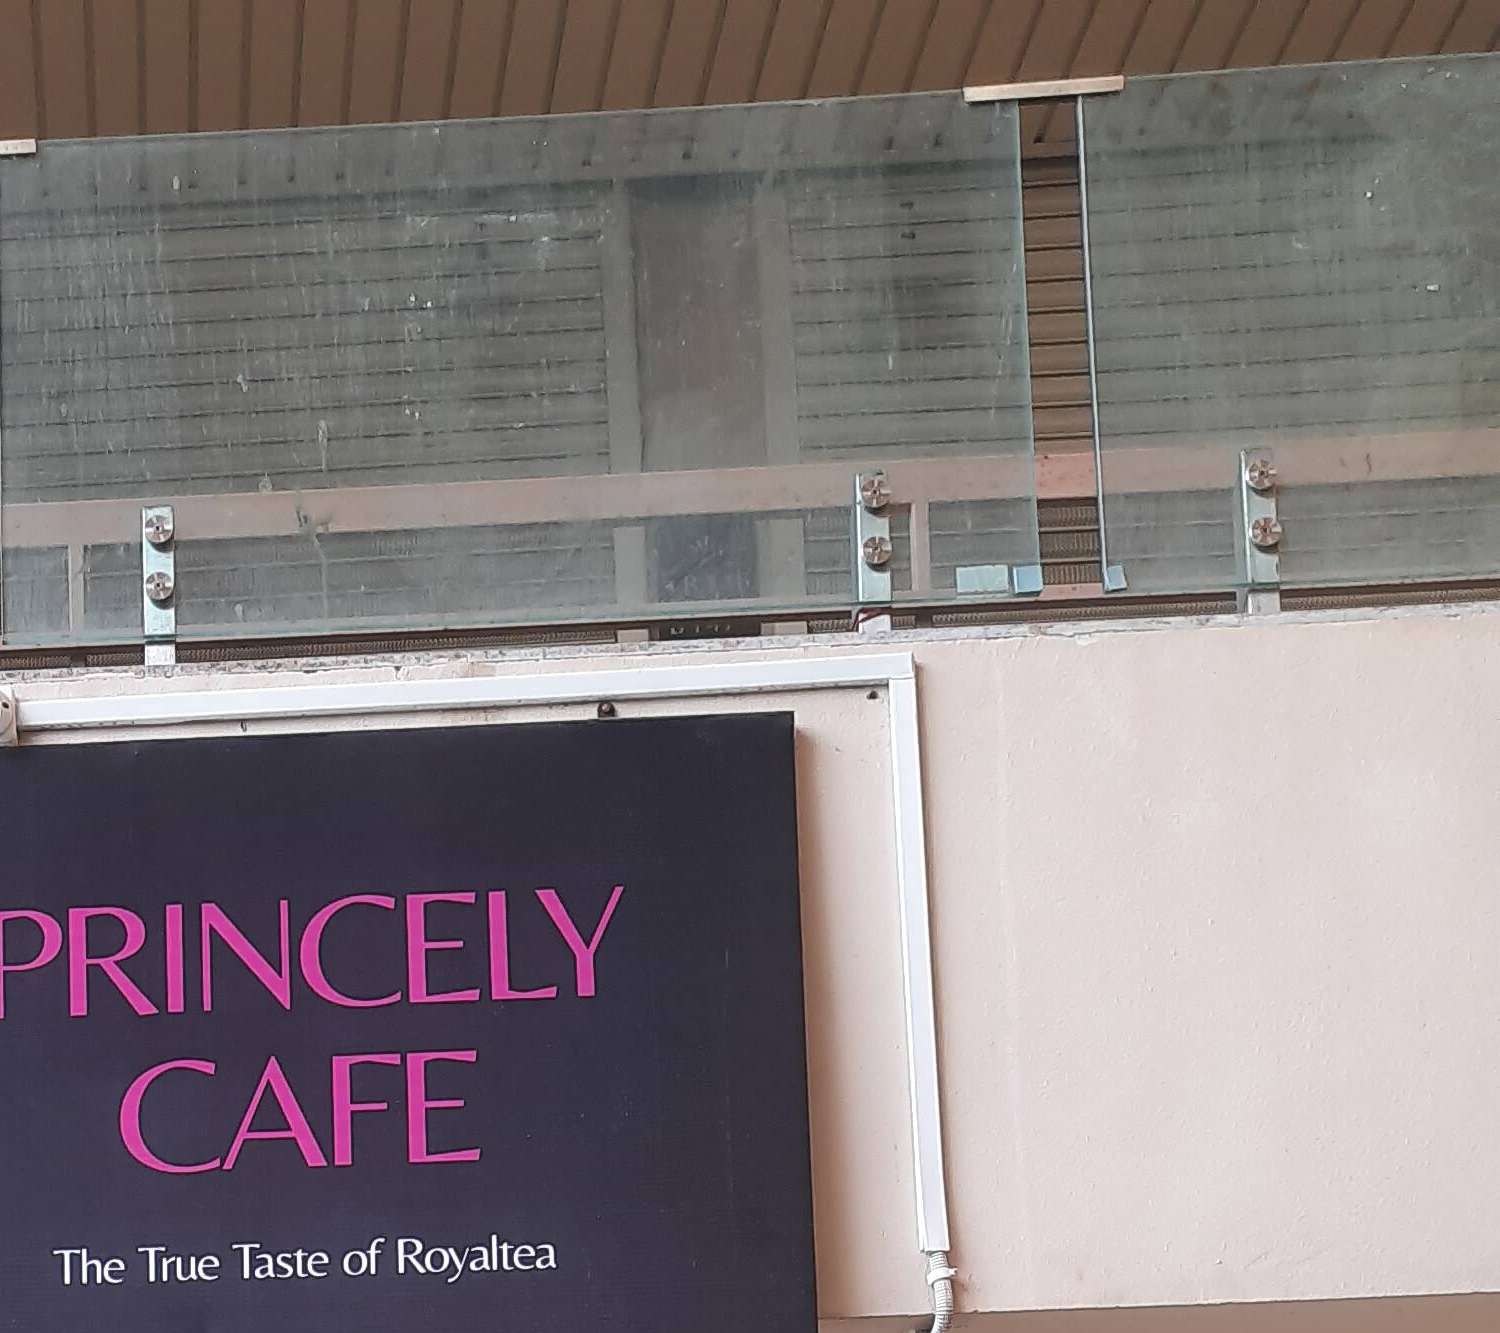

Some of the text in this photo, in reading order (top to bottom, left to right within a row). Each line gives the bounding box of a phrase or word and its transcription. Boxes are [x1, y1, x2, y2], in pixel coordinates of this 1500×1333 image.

[118, 1049, 482, 1175] CAFE
[52, 1233, 558, 1287] The True Taste of Royaltea
